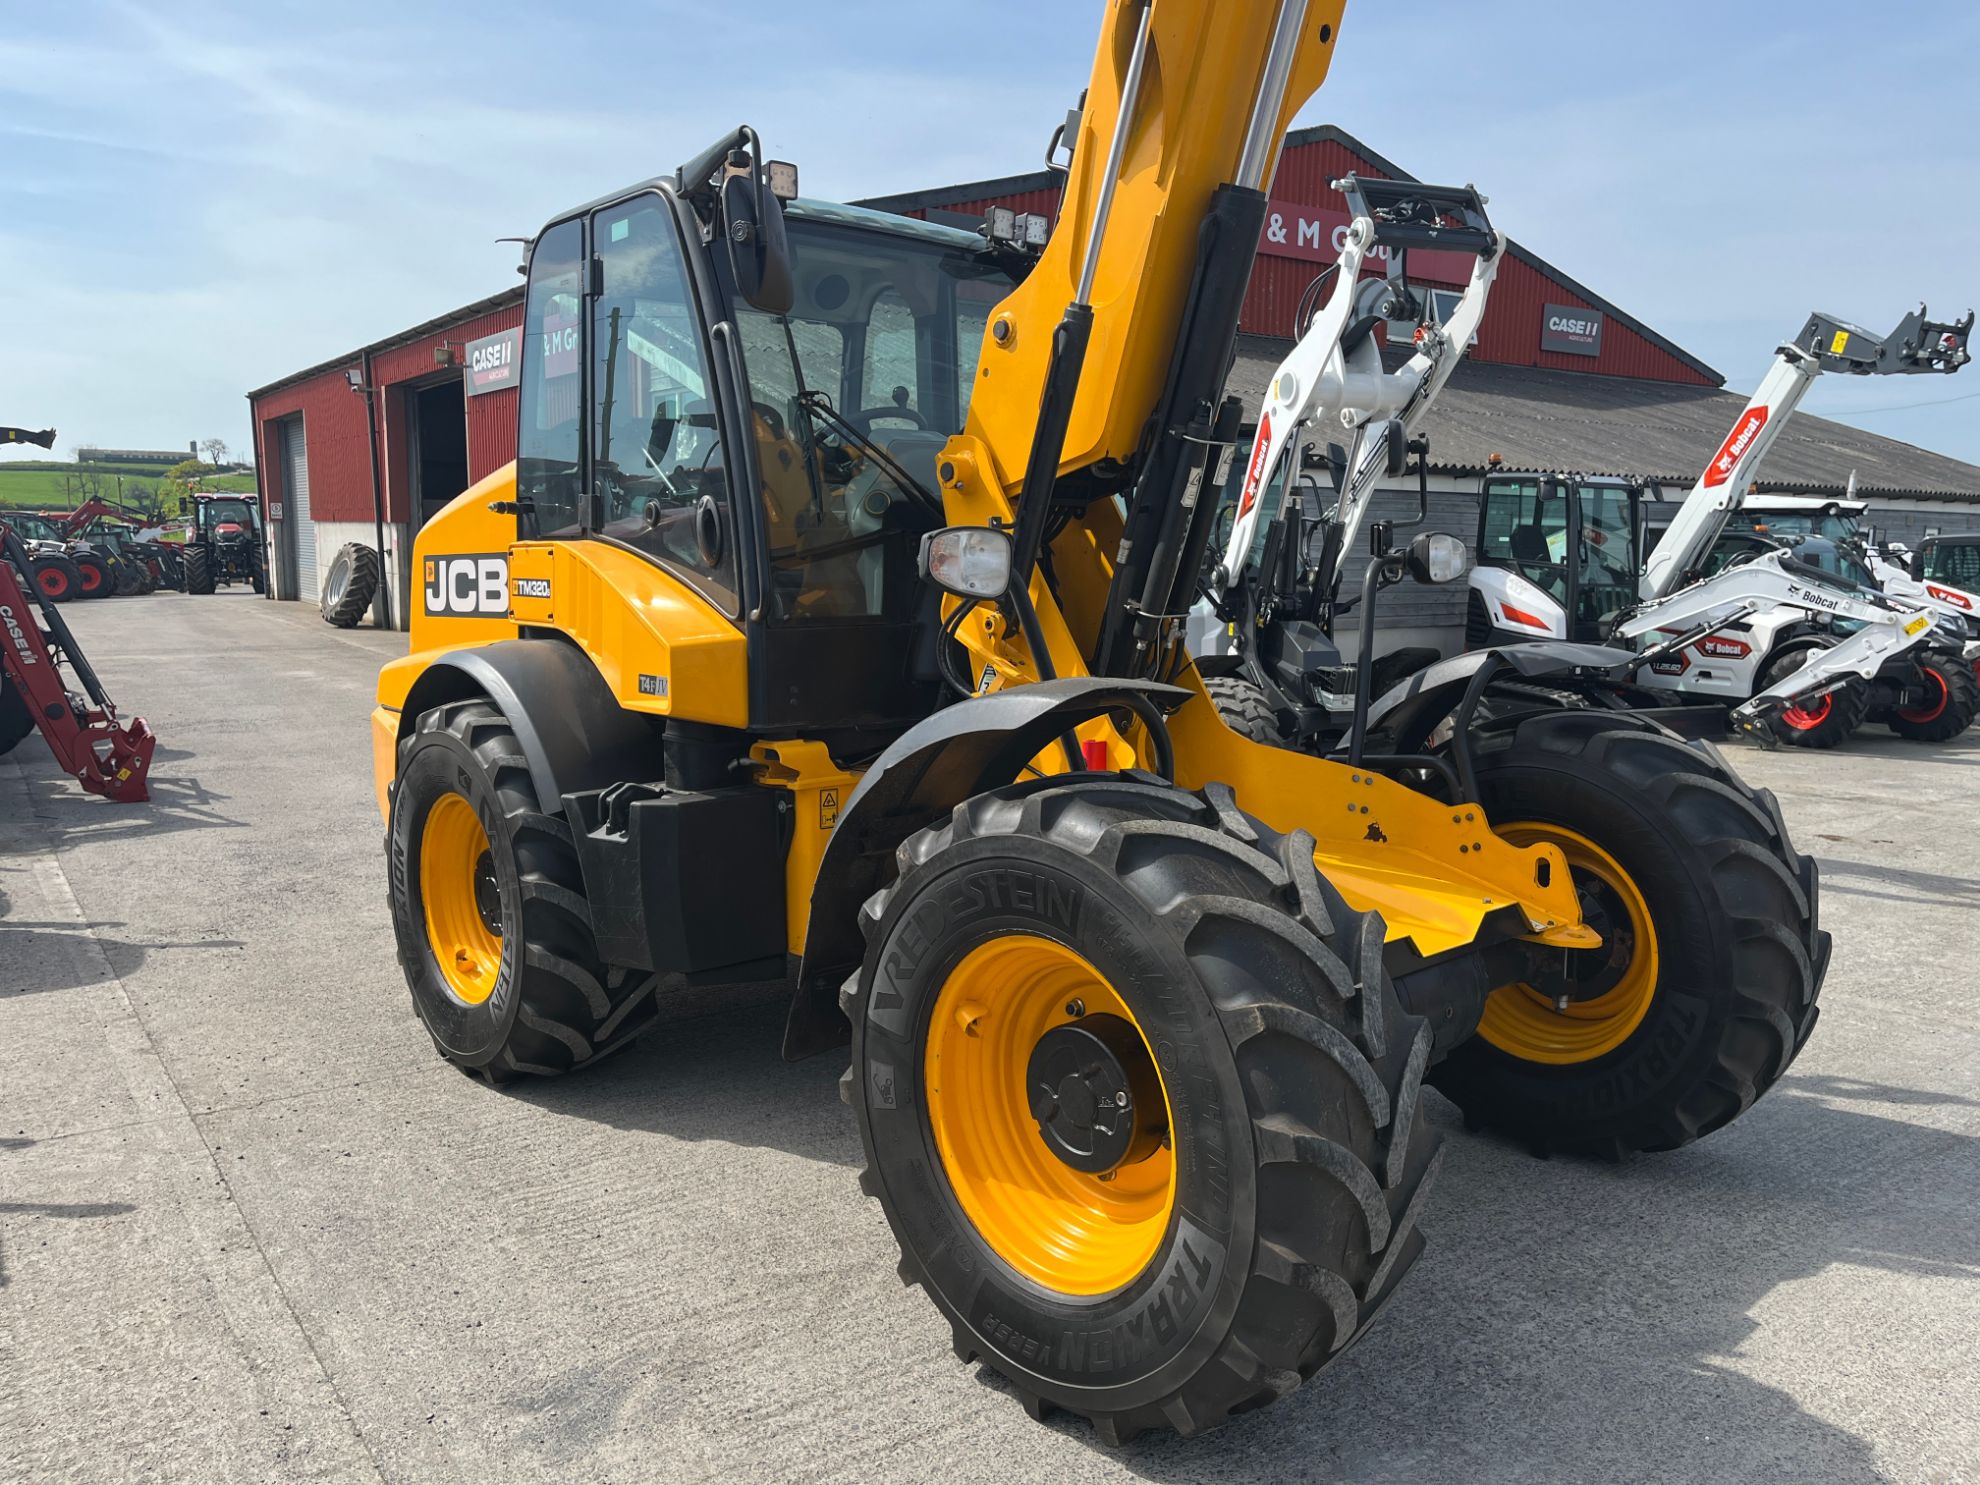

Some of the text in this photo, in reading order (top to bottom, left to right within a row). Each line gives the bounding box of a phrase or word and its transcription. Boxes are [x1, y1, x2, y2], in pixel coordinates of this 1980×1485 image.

[1267, 213, 1287, 244] &
[1297, 218, 1320, 249] M
[544, 334, 551, 356] &
[552, 330, 562, 354] M
[1549, 316, 1586, 334] CASE
[473, 344, 502, 372] CASE
[1729, 417, 1760, 457] Bobcat
[426, 558, 510, 612] JCB
[1802, 590, 1839, 610] Bobcat
[0, 605, 29, 649] CASE
[1716, 643, 1742, 655] Bobcat
[873, 868, 1083, 1010] VREDESTEIN
[1058, 1237, 1213, 1373] TRAXION
